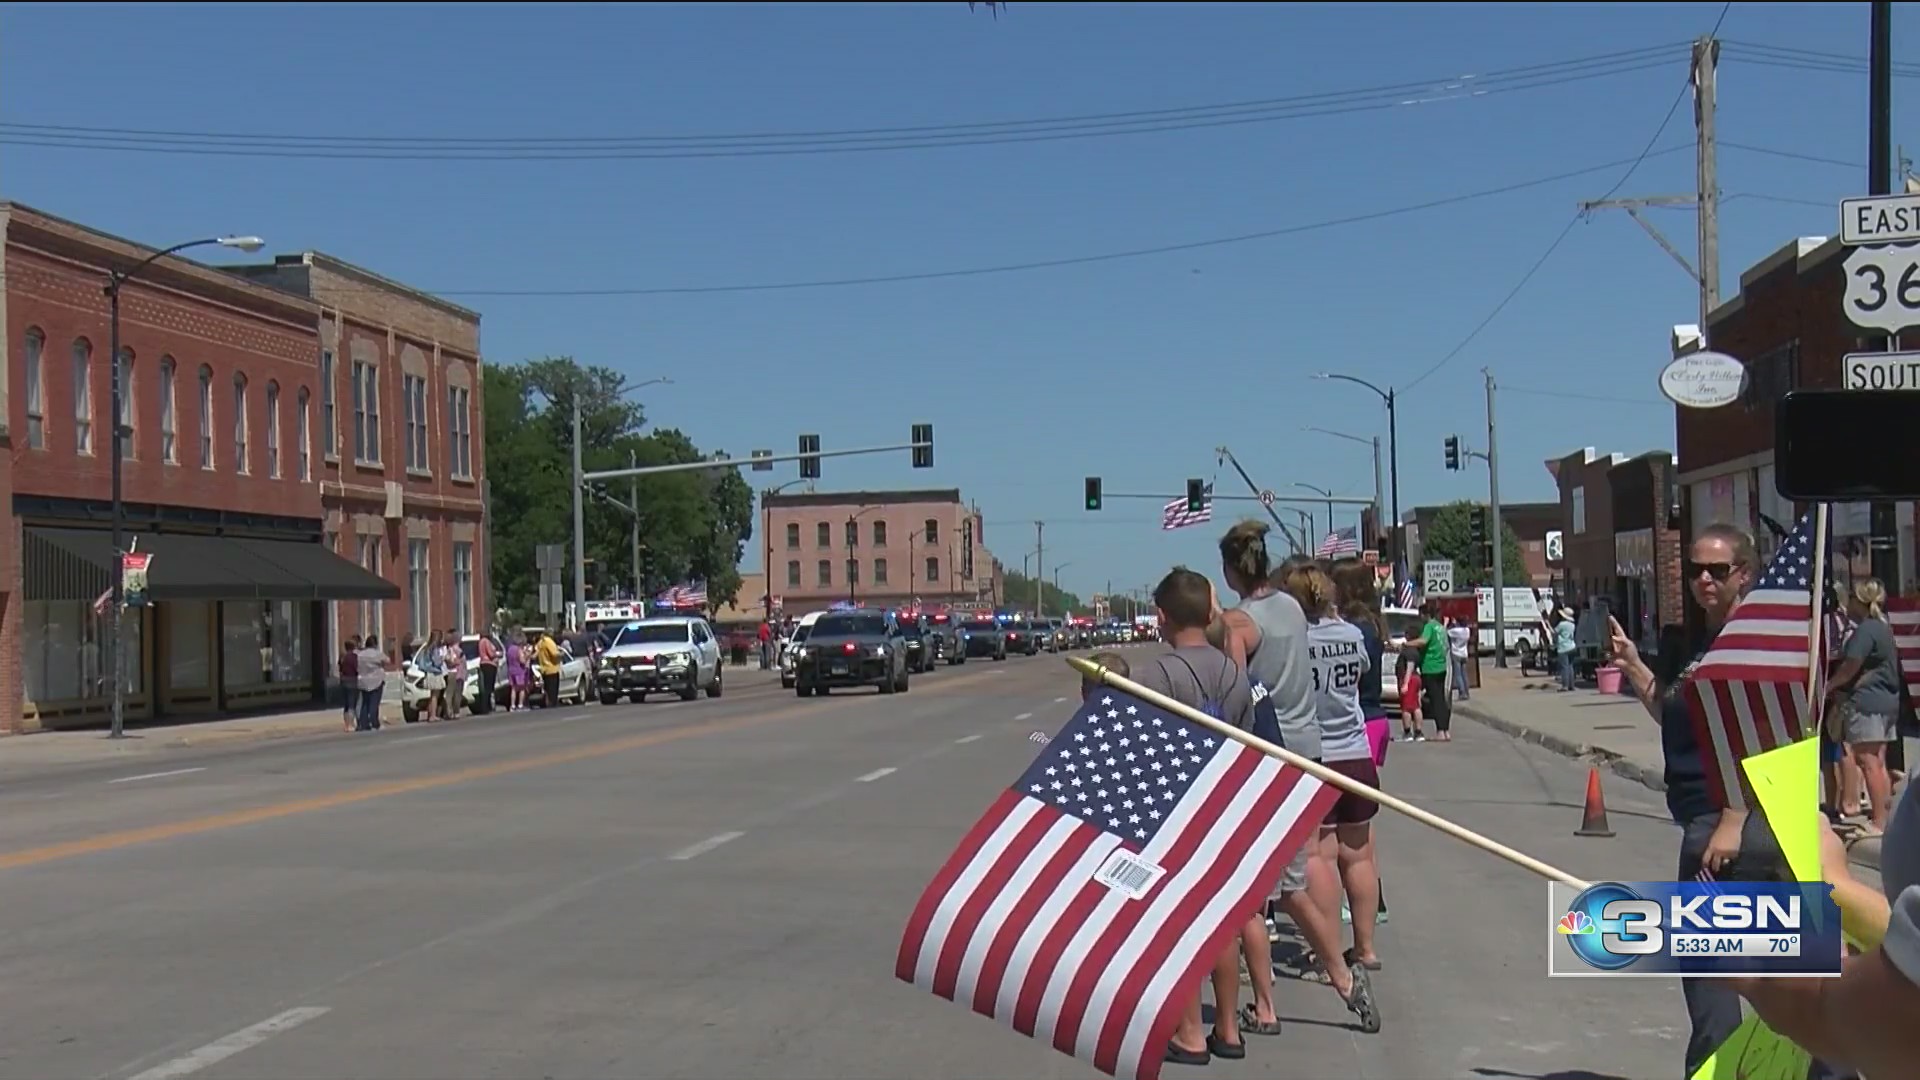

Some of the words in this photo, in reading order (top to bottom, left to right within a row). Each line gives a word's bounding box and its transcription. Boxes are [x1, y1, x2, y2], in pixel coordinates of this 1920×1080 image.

[1858, 206, 1920, 235] EAST
[1854, 262, 1920, 312] 36
[1428, 579, 1450, 592] 20
[1321, 642, 1359, 659] ALLEN
